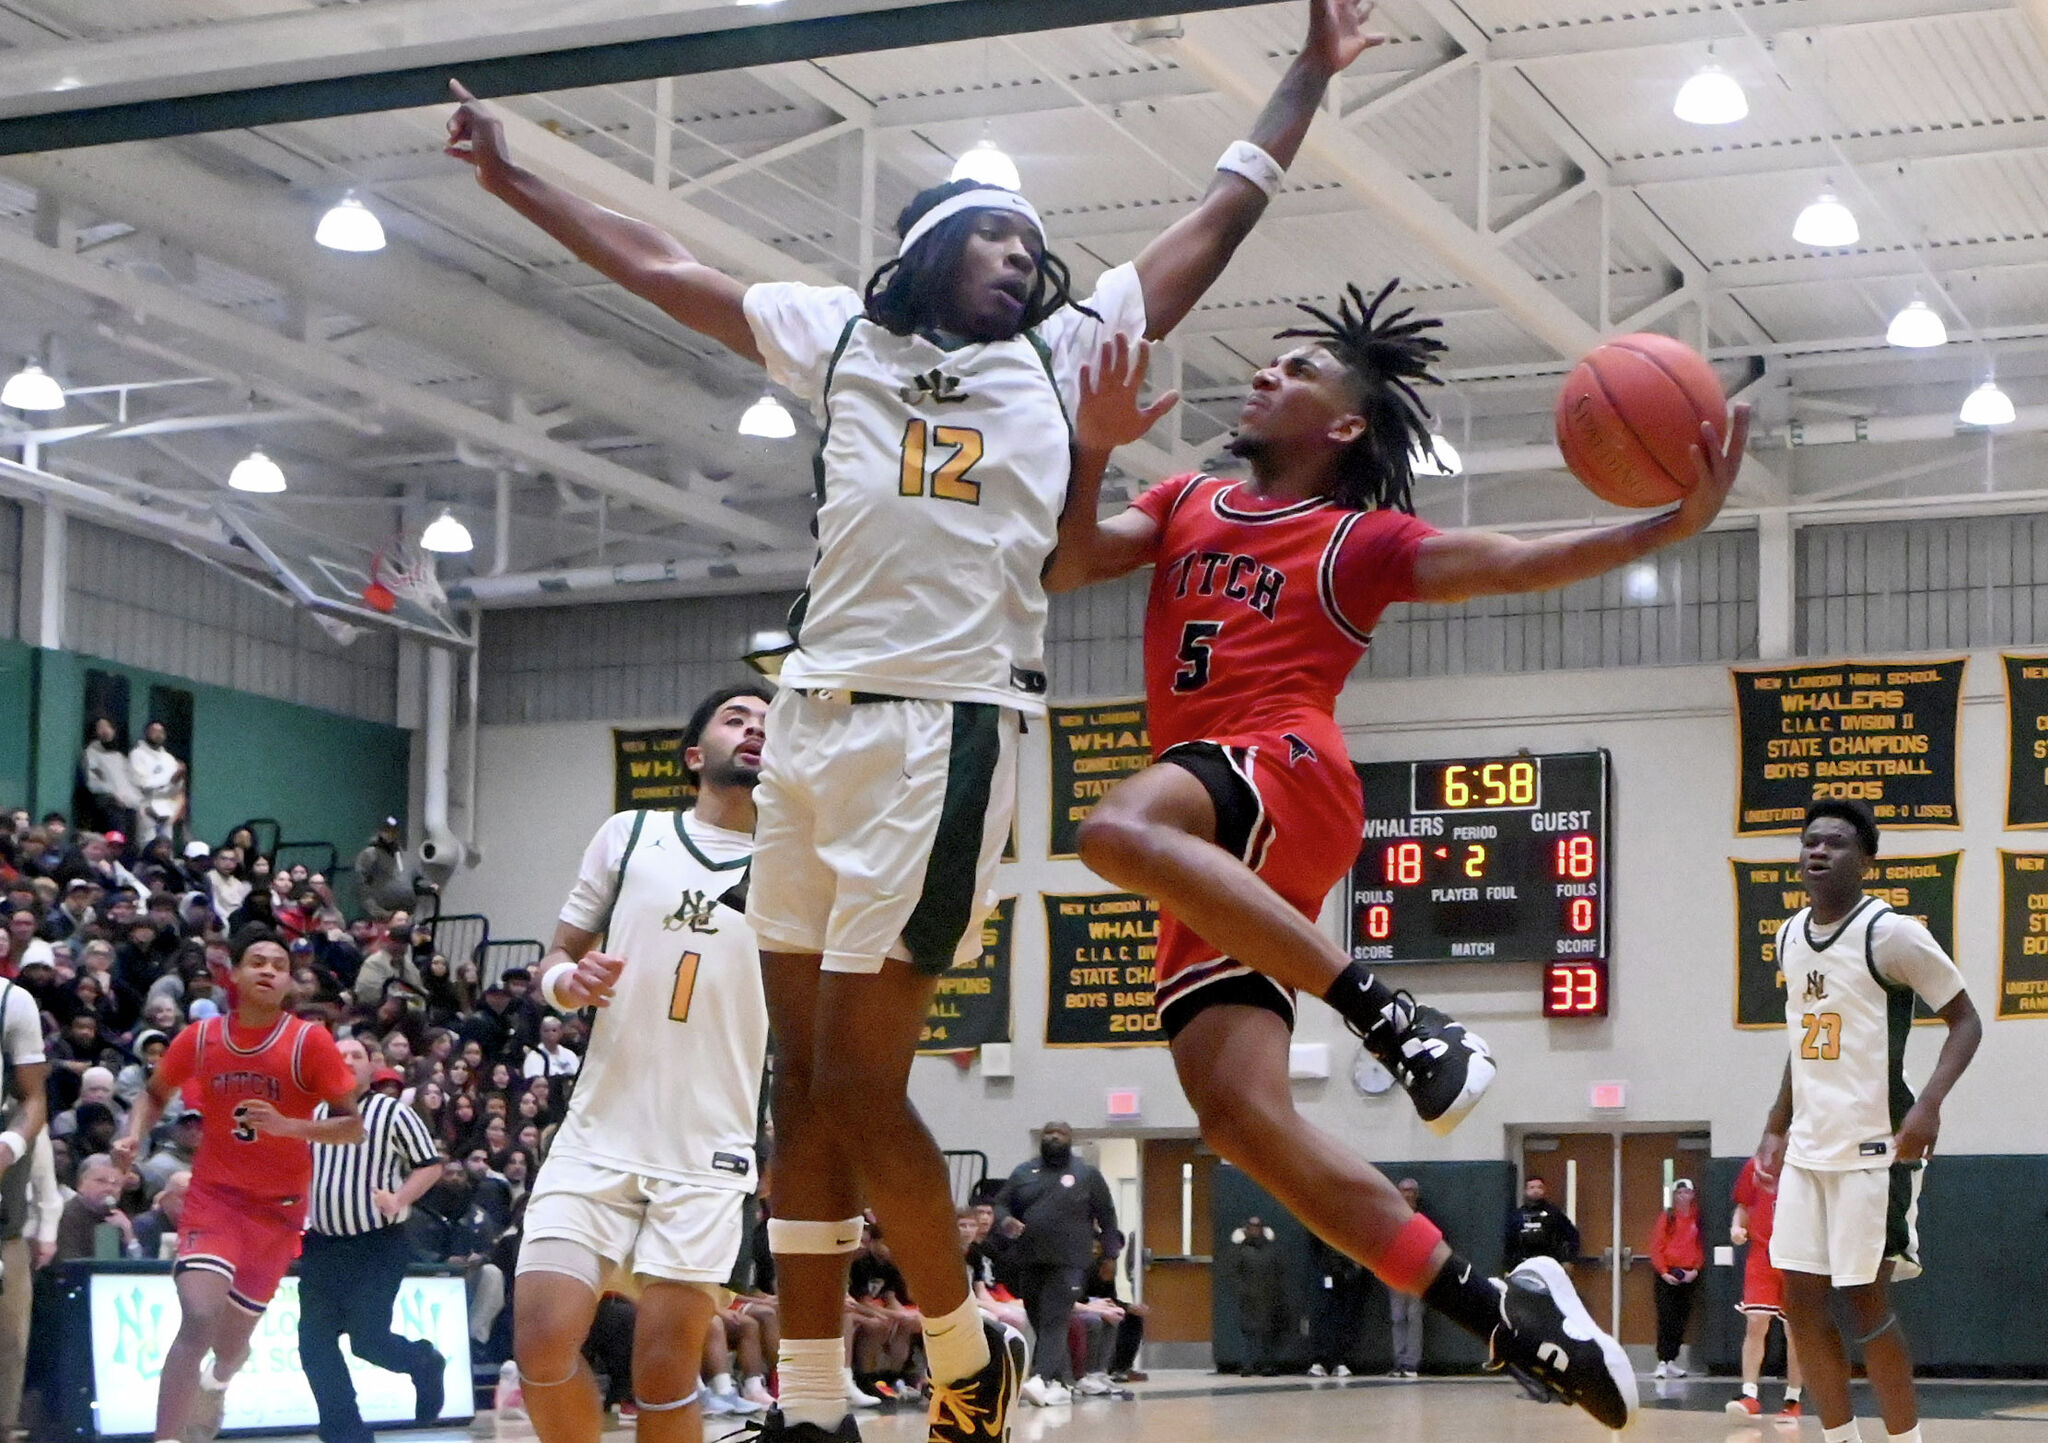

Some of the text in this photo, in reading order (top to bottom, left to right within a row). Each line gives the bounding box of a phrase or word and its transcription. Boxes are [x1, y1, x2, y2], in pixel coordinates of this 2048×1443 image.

[899, 418, 984, 506] 12
[1170, 620, 1224, 696] 5
[1754, 669, 1943, 690] NEW LONDON HIGH SCHOOL
[1781, 690, 1905, 712] WHALERS
[1840, 714, 1895, 730] DIVISION
[1767, 734, 1929, 758] STATE CHAMPIONS
[1764, 758, 1933, 779] BOYS BASKETBALL
[1445, 762, 1534, 806] 6:58
[1812, 780, 1884, 800] 2005
[1914, 804, 1953, 817] LOSSES
[1362, 816, 1444, 839] WHALERS
[1531, 811, 1592, 832] GUEST
[1453, 825, 1497, 840] PERIOD
[1386, 843, 1421, 883] 18
[1465, 845, 1485, 877] 2
[1557, 836, 1593, 877] 18
[2016, 857, 2045, 871] NEW
[1751, 870, 1779, 883] NEW
[1886, 865, 1942, 880] SCHOOL
[1355, 890, 1394, 904] FOULS
[1431, 886, 1517, 902] PLAYER FOUL
[1556, 882, 1597, 897] FOULS
[1090, 900, 1141, 915] LONDON
[1572, 899, 1592, 931] 0
[1369, 905, 1389, 938] 0
[1354, 945, 1394, 960] SCORE
[1451, 942, 1495, 957] MATCH
[1556, 939, 1597, 954] SCORE
[668, 950, 701, 1023] 1
[1070, 967, 1120, 985] STATE
[1551, 968, 1598, 1010] 33
[1065, 992, 1108, 1008] BOYS
[1801, 1012, 1842, 1060] 23
